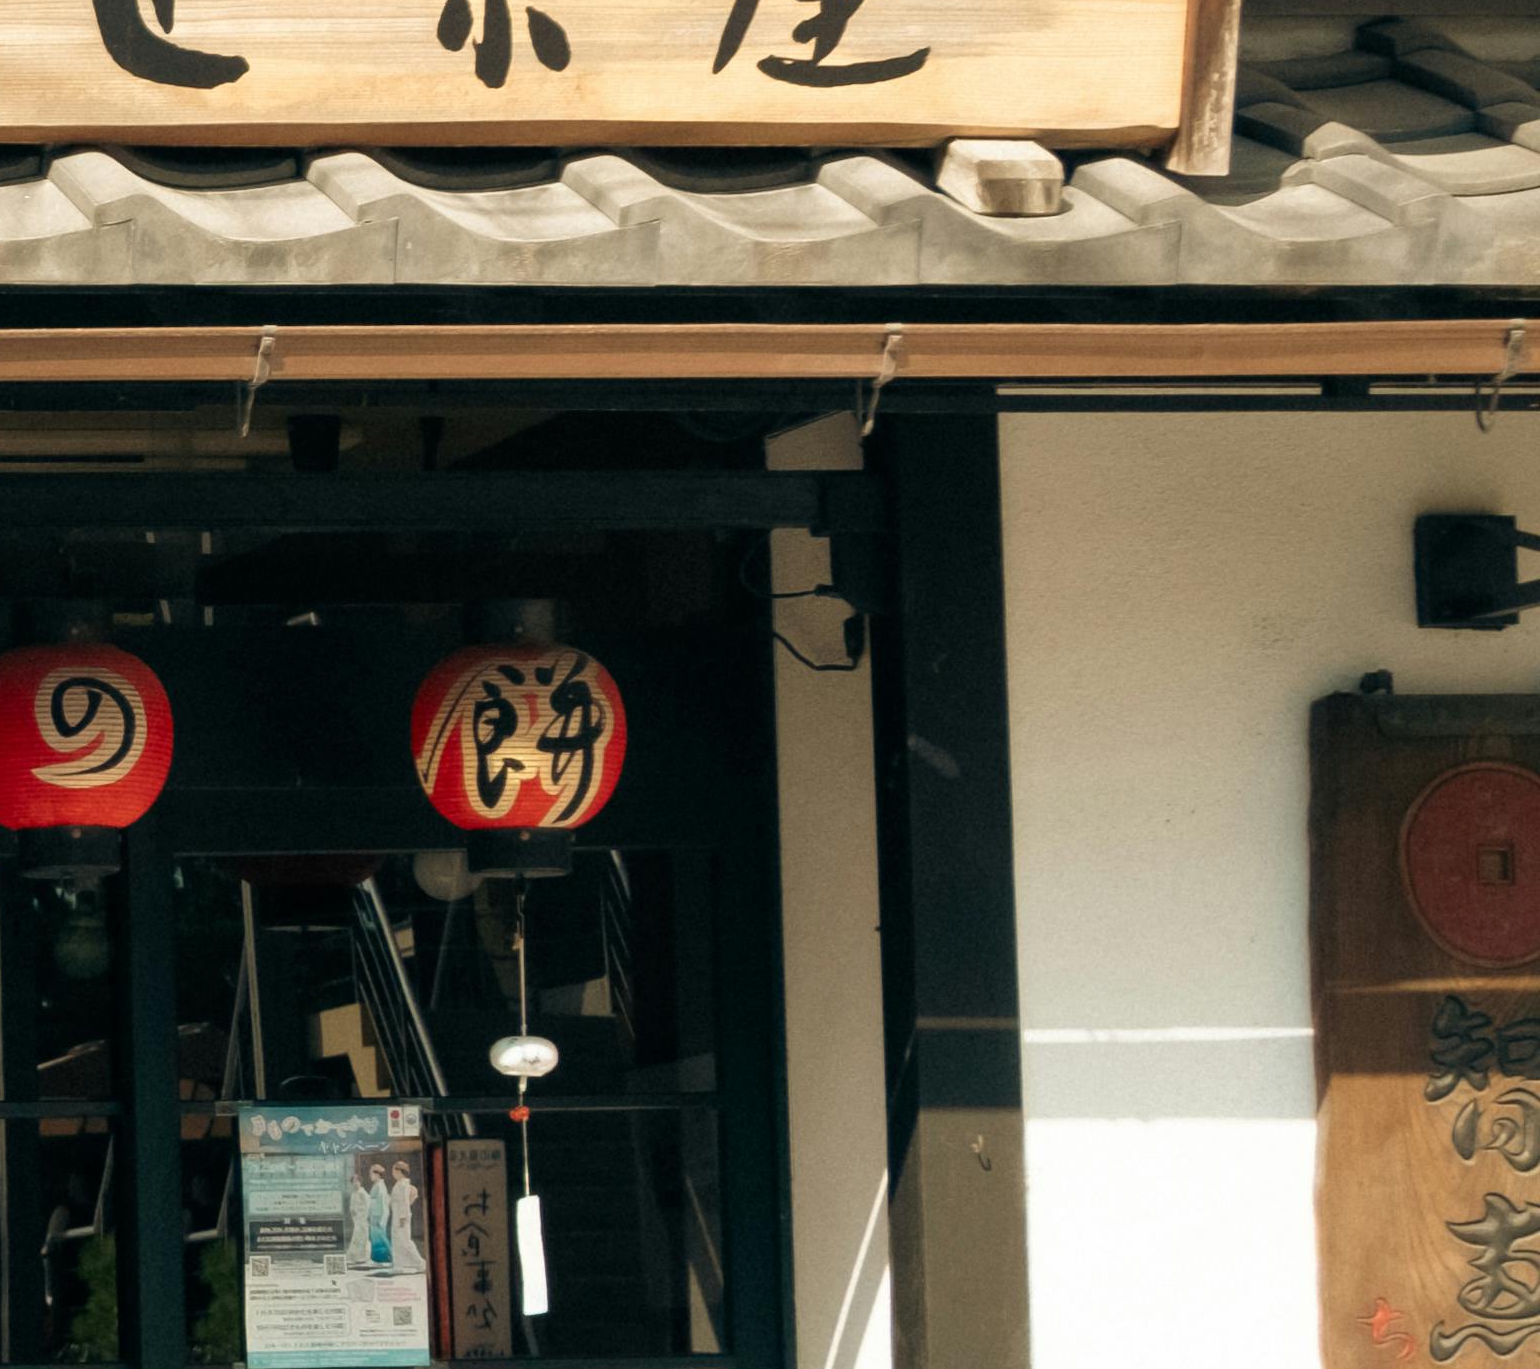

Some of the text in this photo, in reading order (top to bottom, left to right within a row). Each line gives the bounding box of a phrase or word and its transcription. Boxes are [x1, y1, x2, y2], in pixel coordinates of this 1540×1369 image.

[45, 674, 137, 773] の
[318, 1140, 391, 1155] キャンペーン
